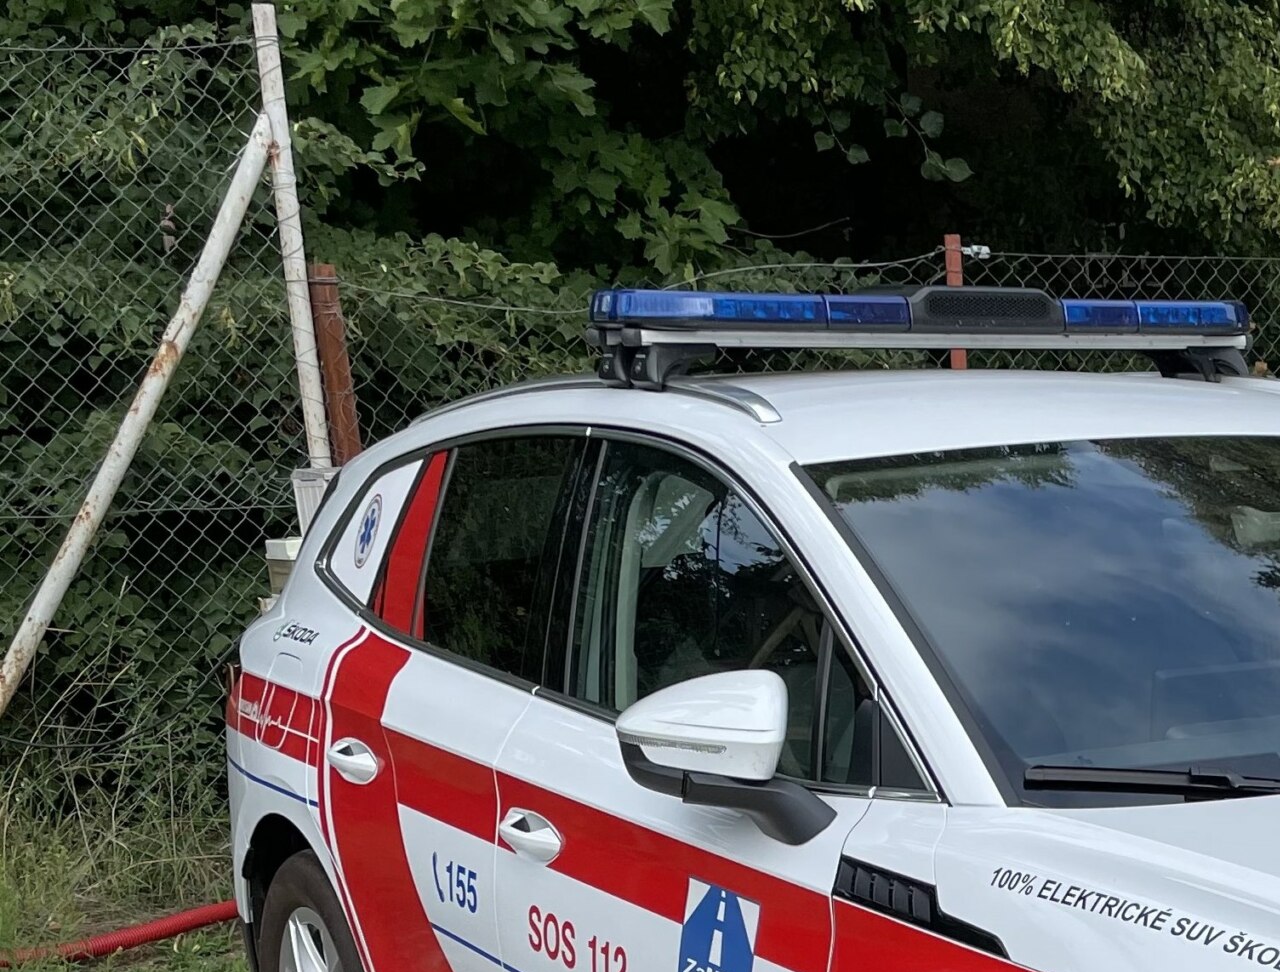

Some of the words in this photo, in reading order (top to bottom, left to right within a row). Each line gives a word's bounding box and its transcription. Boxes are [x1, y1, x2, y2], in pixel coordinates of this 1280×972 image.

[445, 860, 478, 914] 155
[990, 867, 1037, 896] 100%
[1036, 879, 1172, 931] ELEKTRICKÉ
[1170, 917, 1226, 947] SUV
[527, 904, 577, 970] SOS
